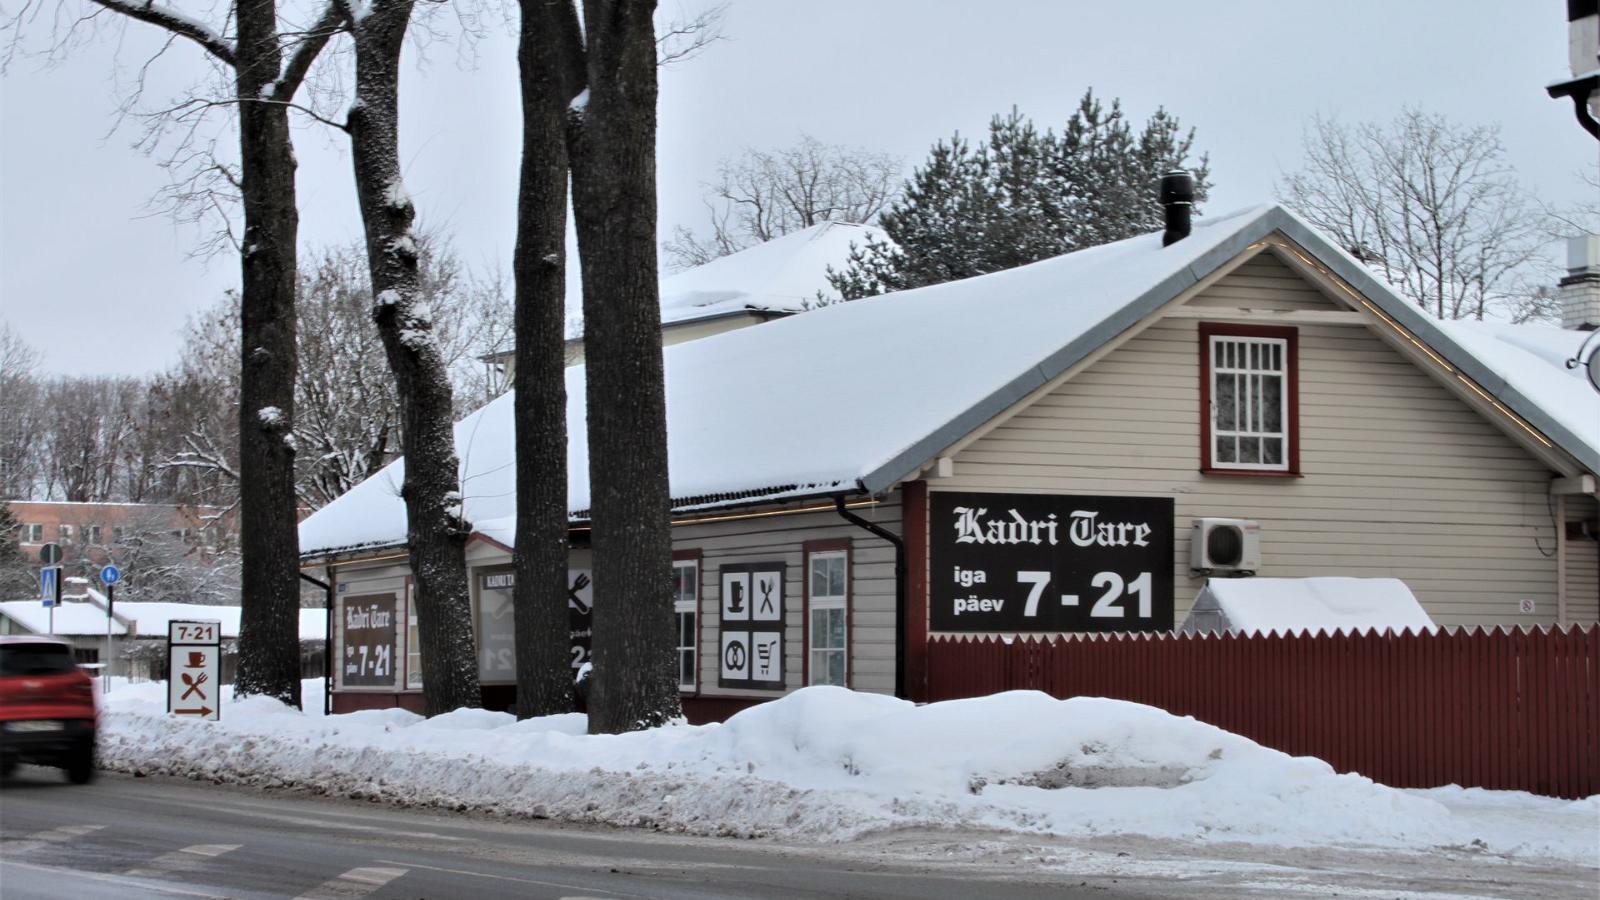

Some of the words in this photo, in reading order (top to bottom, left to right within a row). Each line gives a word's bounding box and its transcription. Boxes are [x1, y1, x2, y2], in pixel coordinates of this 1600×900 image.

[953, 506, 1059, 545] Kadri
[1069, 510, 1151, 547] Tare
[954, 566, 986, 587] iga
[954, 596, 1004, 615] päev
[178, 626, 212, 640] 7-21
